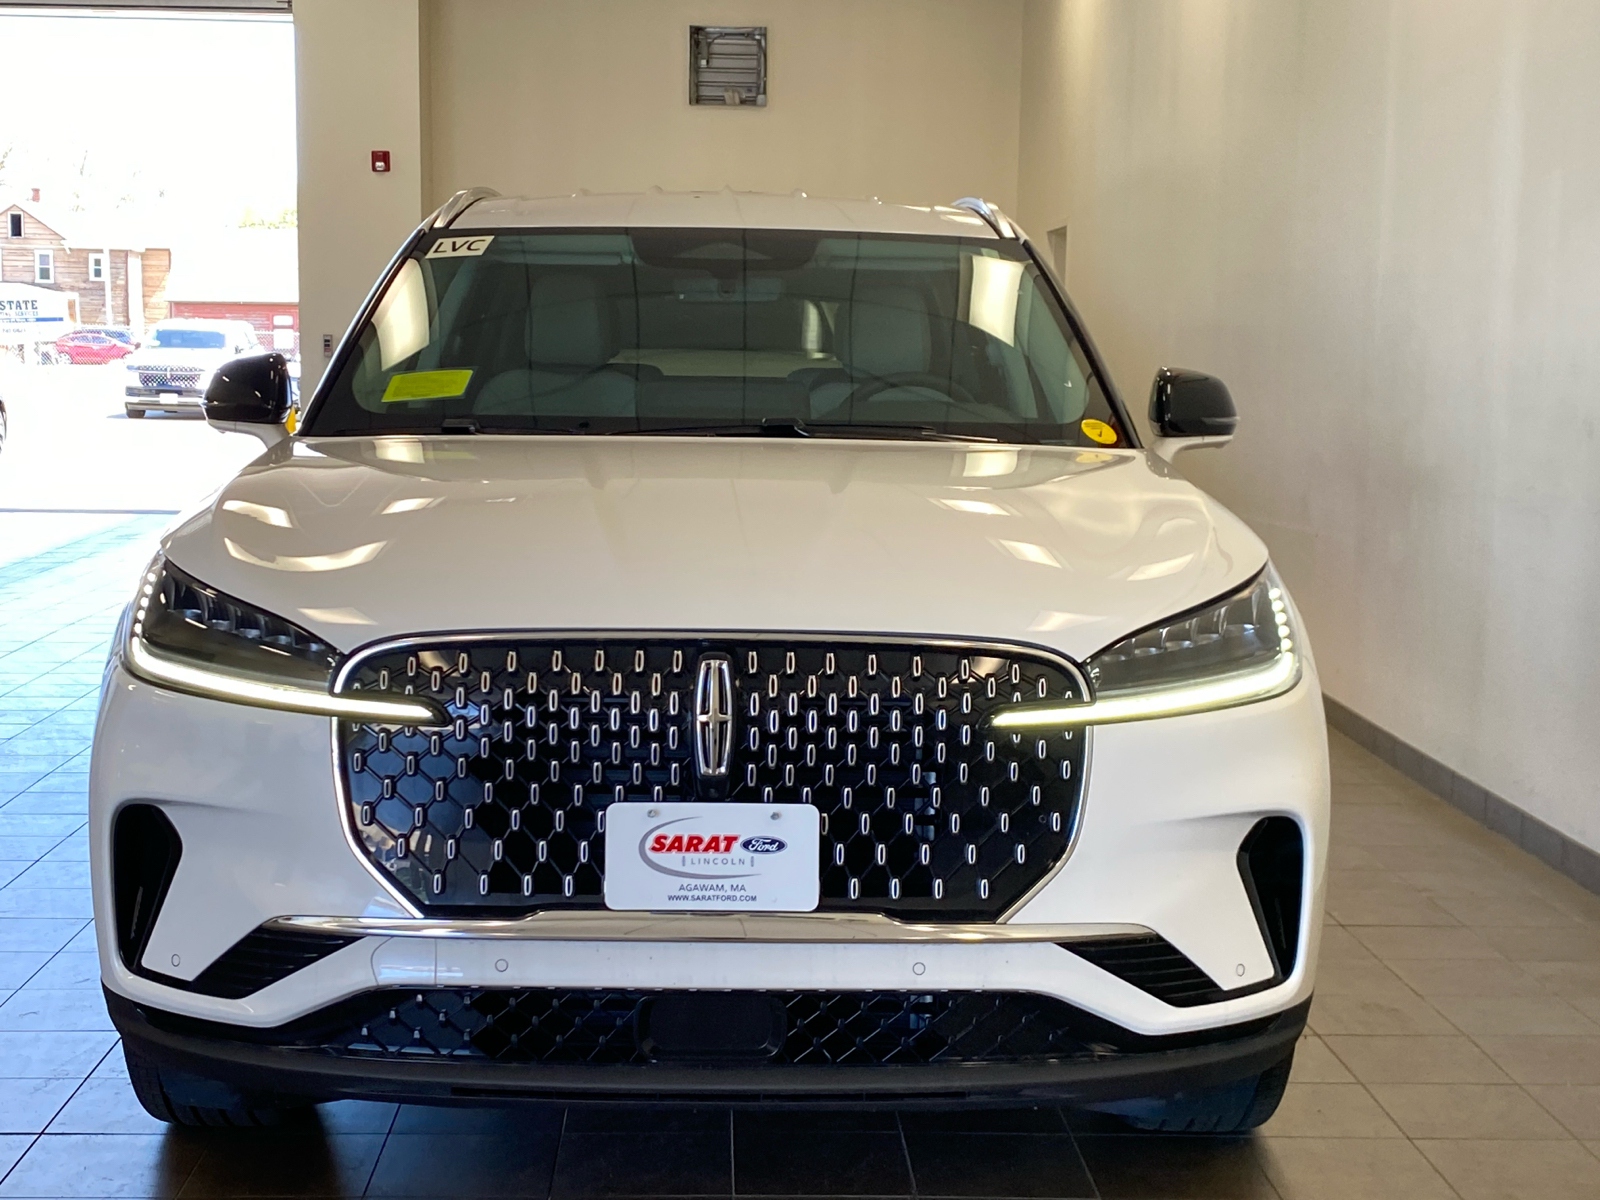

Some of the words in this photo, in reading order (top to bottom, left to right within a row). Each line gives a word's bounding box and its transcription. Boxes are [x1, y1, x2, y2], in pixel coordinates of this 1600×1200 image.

[433, 239, 486, 253] LVC
[0, 300, 38, 311] STATE
[649, 833, 740, 854] SARAT
[747, 837, 780, 852] Ford
[690, 857, 746, 866] LINCOLN
[678, 883, 728, 893] AGAWAM,
[730, 883, 747, 892] MA
[667, 894, 757, 902] WWW.SARATFORD.COM
